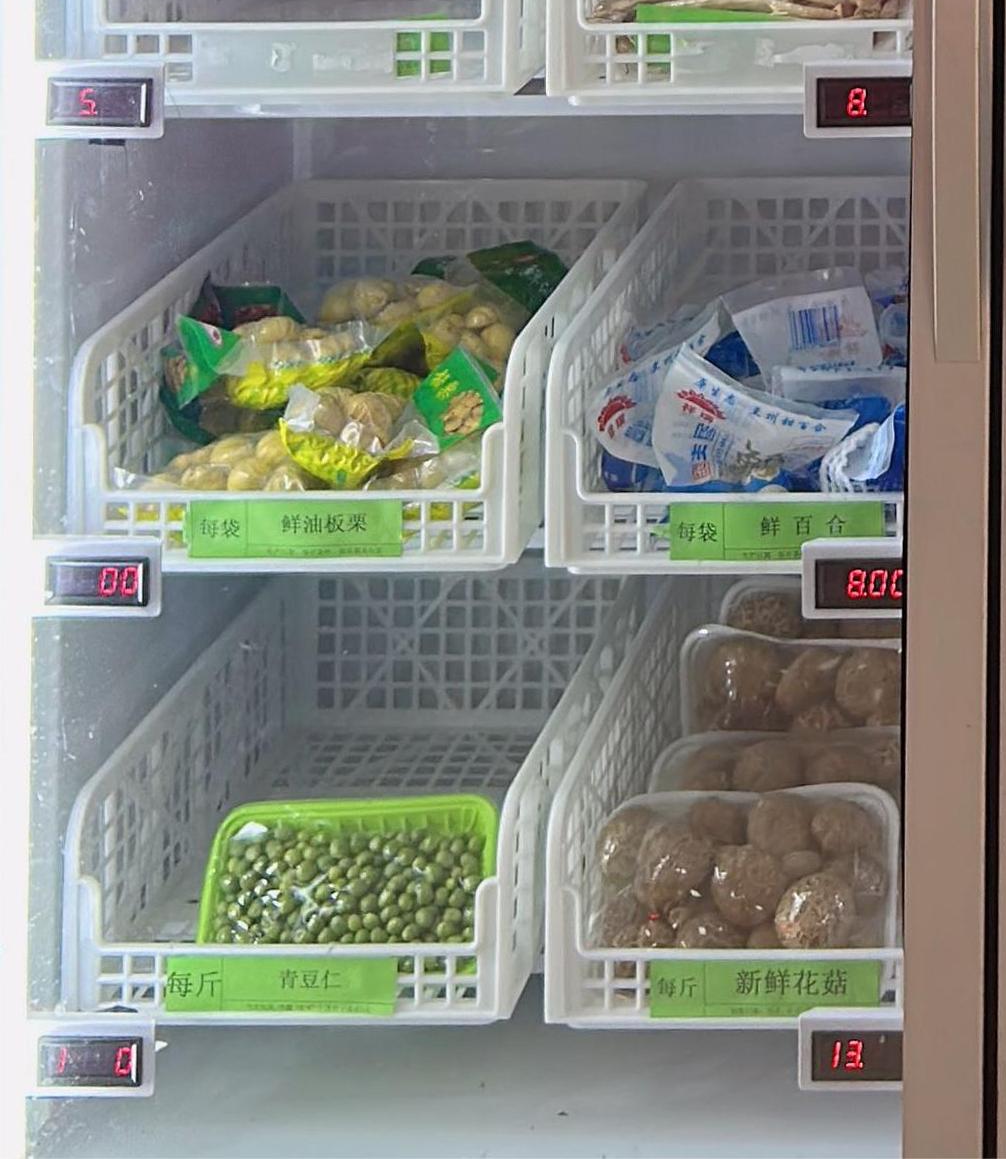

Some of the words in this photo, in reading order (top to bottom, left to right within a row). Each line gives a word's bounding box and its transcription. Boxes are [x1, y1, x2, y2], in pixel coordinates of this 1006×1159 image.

[199, 519, 241, 539] 每袋
[281, 512, 368, 534] 鲜油板栗
[678, 522, 719, 542] 每袋
[760, 514, 848, 537] 鲜百合
[98, 566, 139, 597] 00
[167, 971, 222, 998] 每斤
[279, 968, 342, 990] 青豆仁
[656, 976, 698, 998] 每斤
[735, 968, 848, 996] 新鲜花菇
